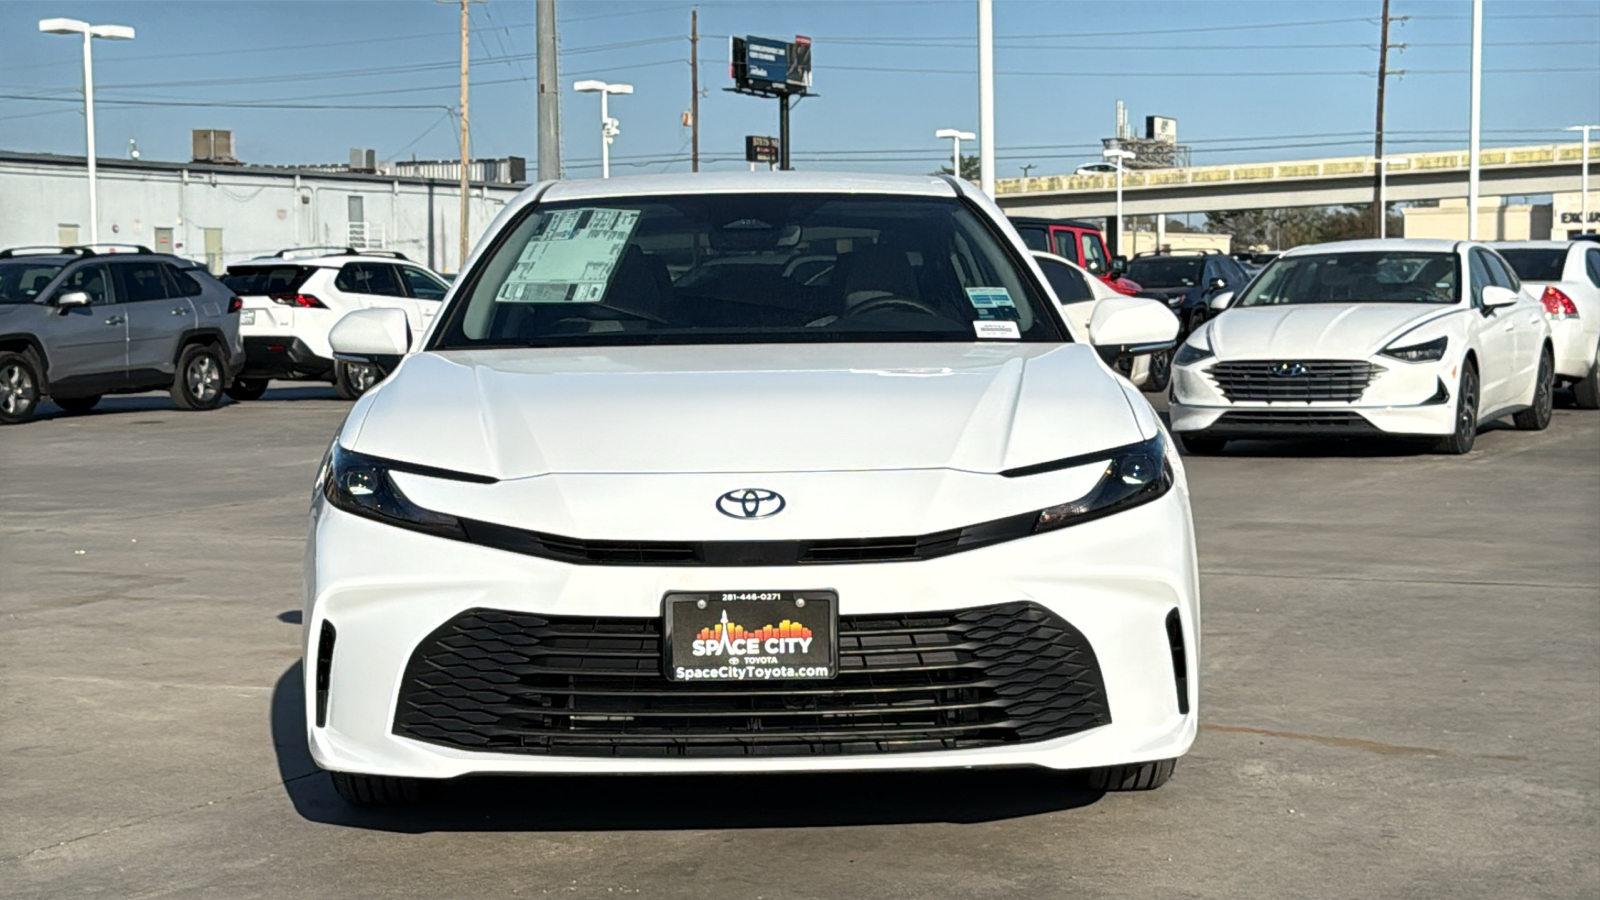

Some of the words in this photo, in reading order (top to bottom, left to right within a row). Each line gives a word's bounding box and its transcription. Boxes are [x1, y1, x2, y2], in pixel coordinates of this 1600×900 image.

[722, 593, 781, 601] 281-446-0271
[692, 638, 760, 656] SPACE
[764, 637, 813, 654] CITY
[743, 656, 778, 665] TOYOTA
[676, 666, 828, 680] SpaceCityToyota.com
